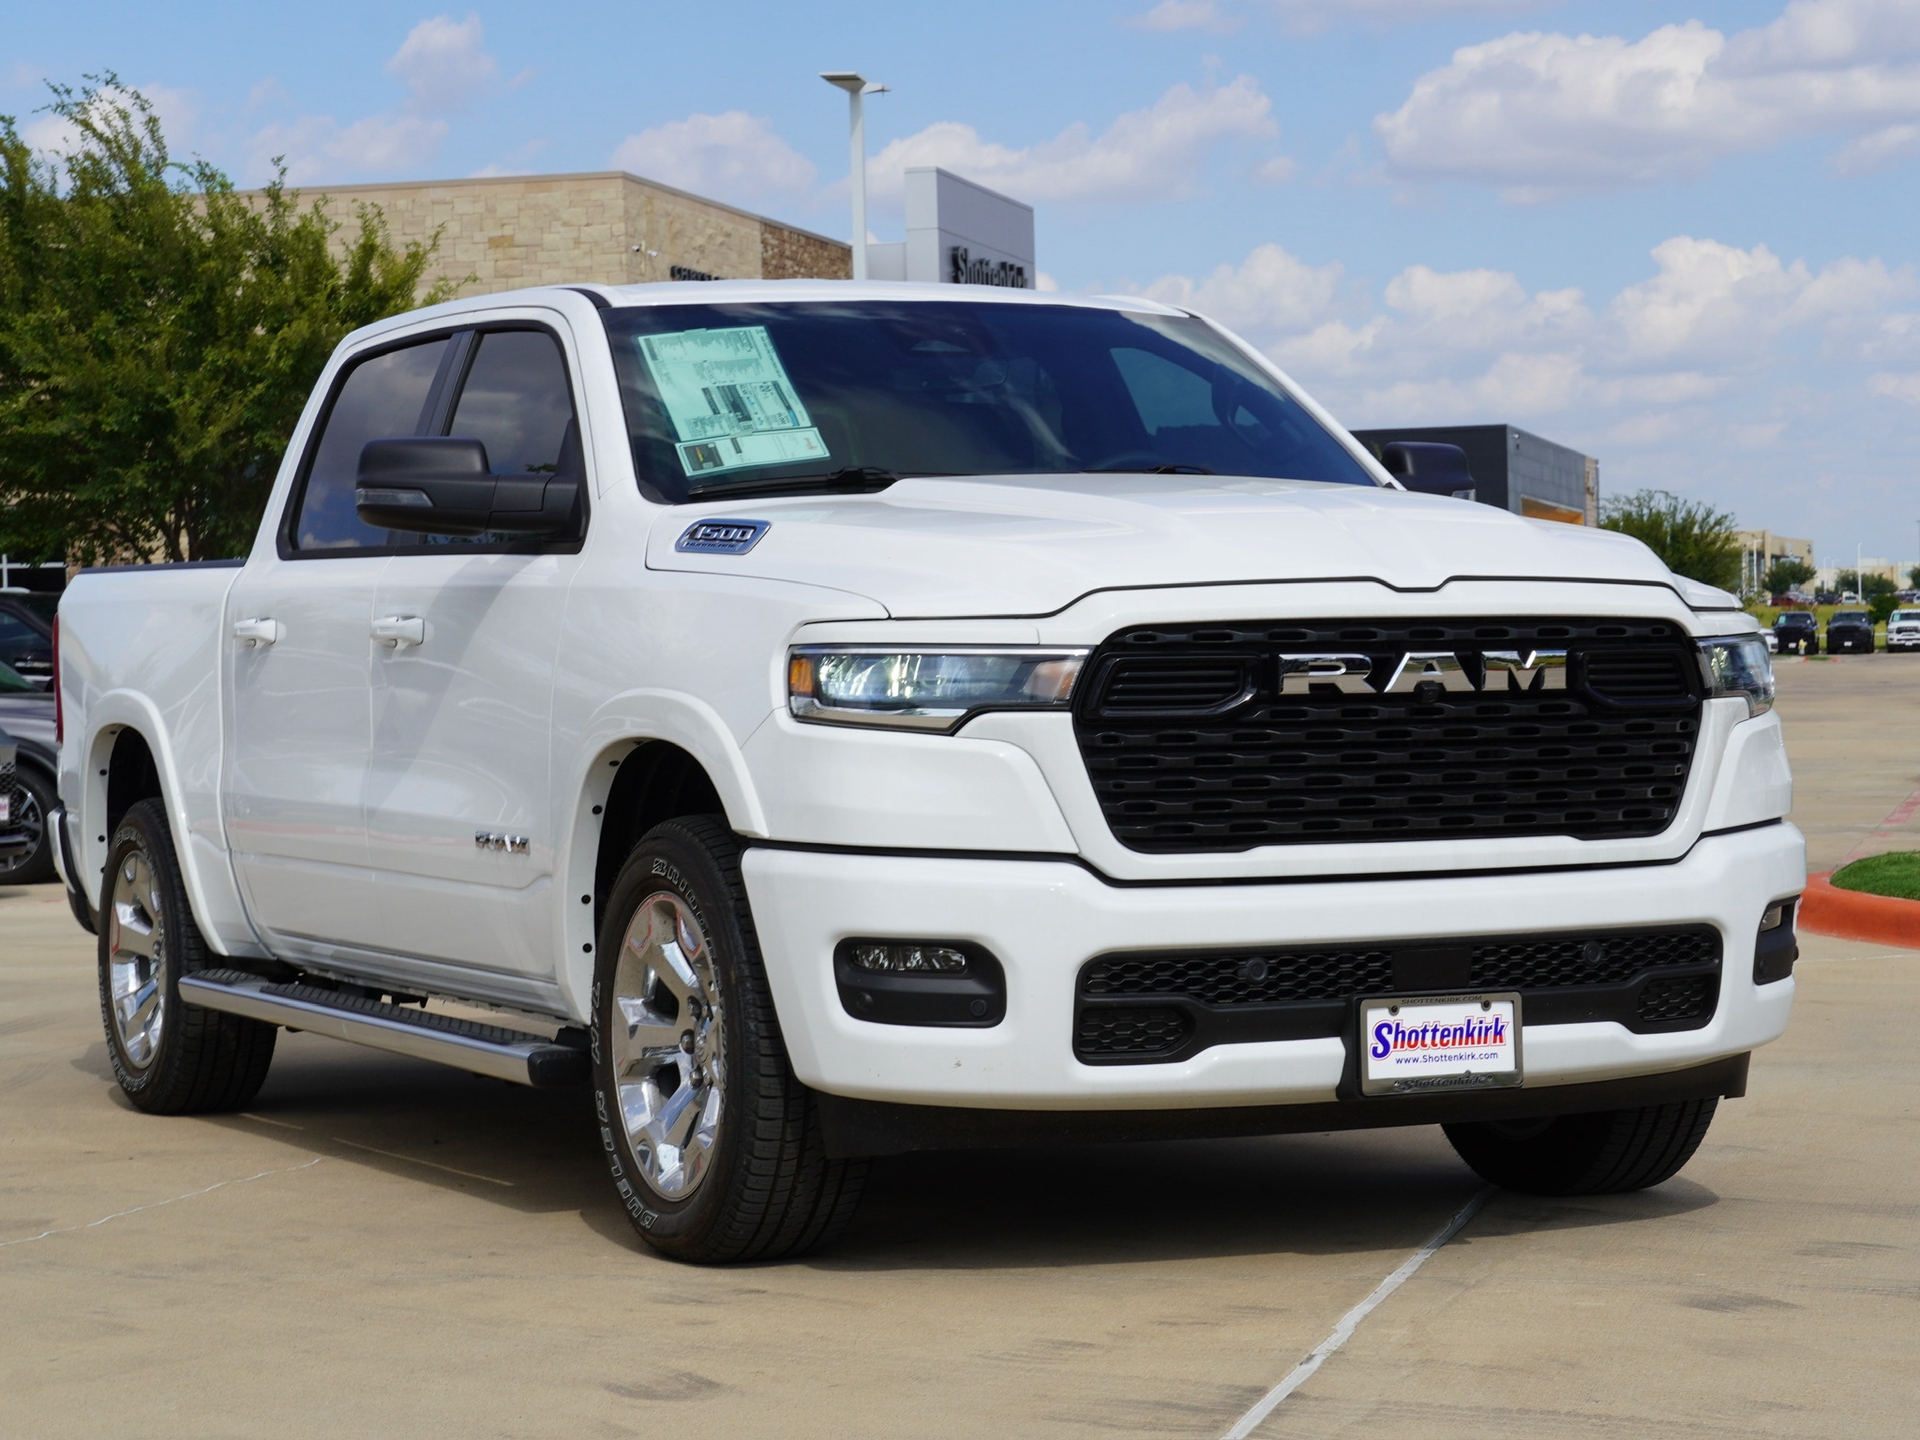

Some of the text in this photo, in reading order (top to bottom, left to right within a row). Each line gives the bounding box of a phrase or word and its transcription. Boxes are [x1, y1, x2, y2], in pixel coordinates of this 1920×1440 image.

[691, 525, 756, 541] 1500
[1279, 650, 1568, 694] RAM
[1372, 1016, 1507, 1059] Shottenkirk
[1395, 1051, 1499, 1065] www.Shottenkirk.com
